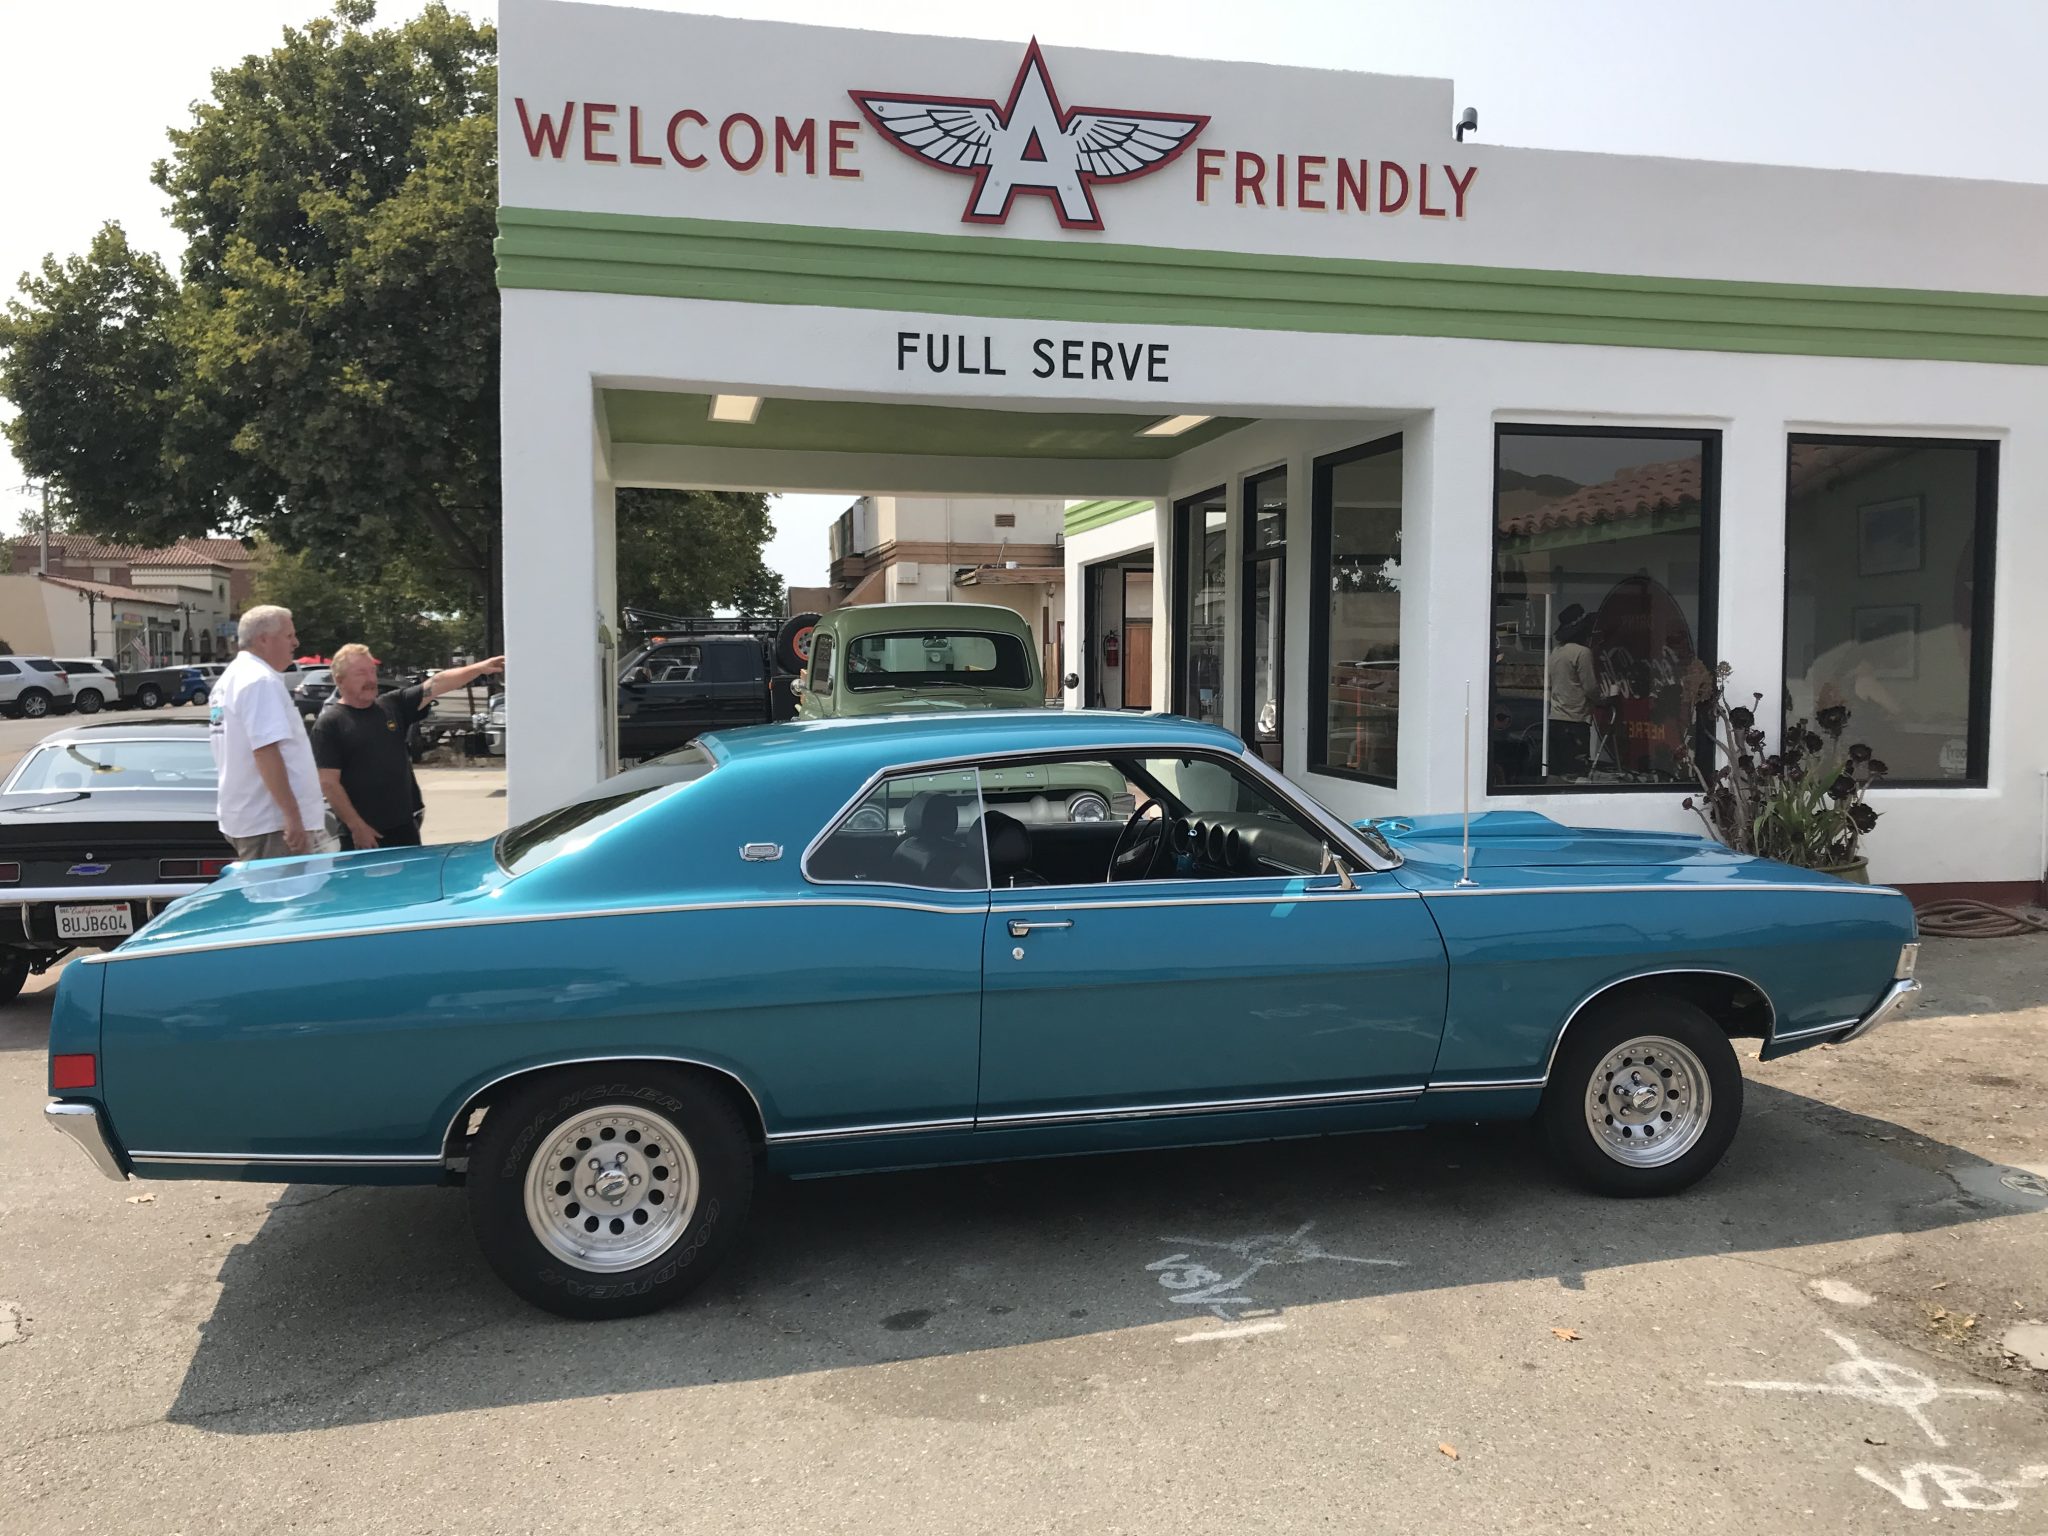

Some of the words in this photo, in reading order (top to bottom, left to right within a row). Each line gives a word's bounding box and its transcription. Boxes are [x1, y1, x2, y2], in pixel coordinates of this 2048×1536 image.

[514, 97, 863, 179] WELCOME
[1196, 148, 1478, 218] FRIENDLY
[898, 332, 1006, 375] FULL
[1032, 338, 1169, 382] SERVE
[62, 915, 127, 932] 8UJB604
[502, 1084, 682, 1178] WRANGLER
[538, 1198, 721, 1298] GOODYEAR
